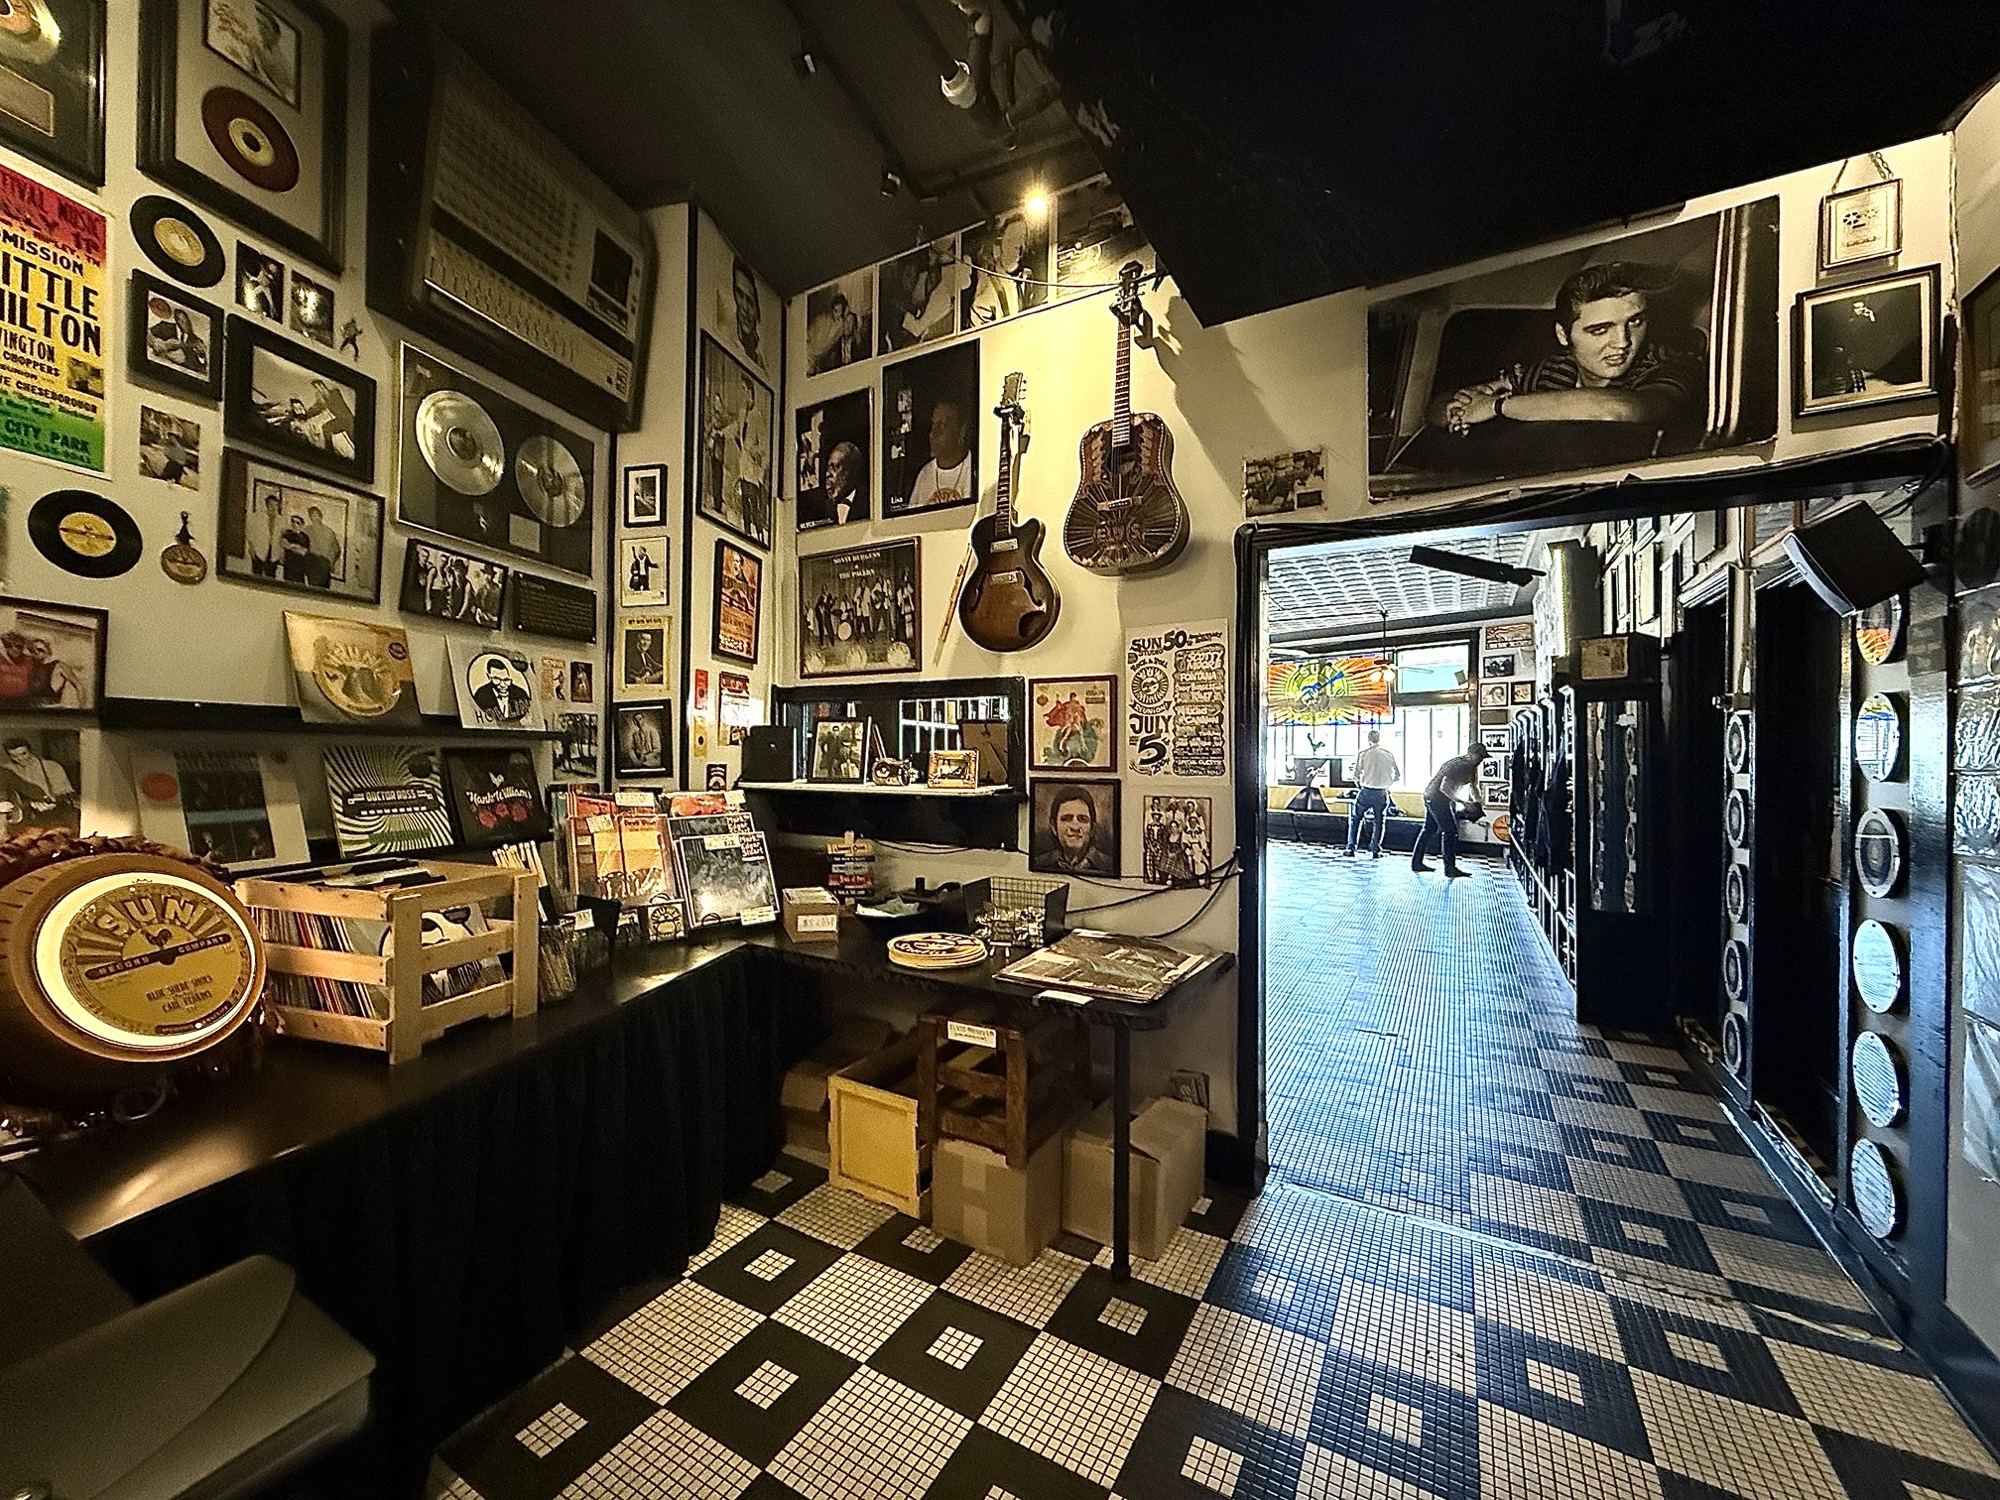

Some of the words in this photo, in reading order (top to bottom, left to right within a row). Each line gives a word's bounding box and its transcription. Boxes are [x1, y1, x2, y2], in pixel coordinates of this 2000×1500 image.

[1130, 637, 1162, 652] SUN
[1128, 714, 1173, 735] JULY
[1137, 729, 1168, 766] 5
[96, 892, 194, 938] SUN
[98, 956, 151, 977] RECORD
[178, 935, 226, 954] COMPANY
